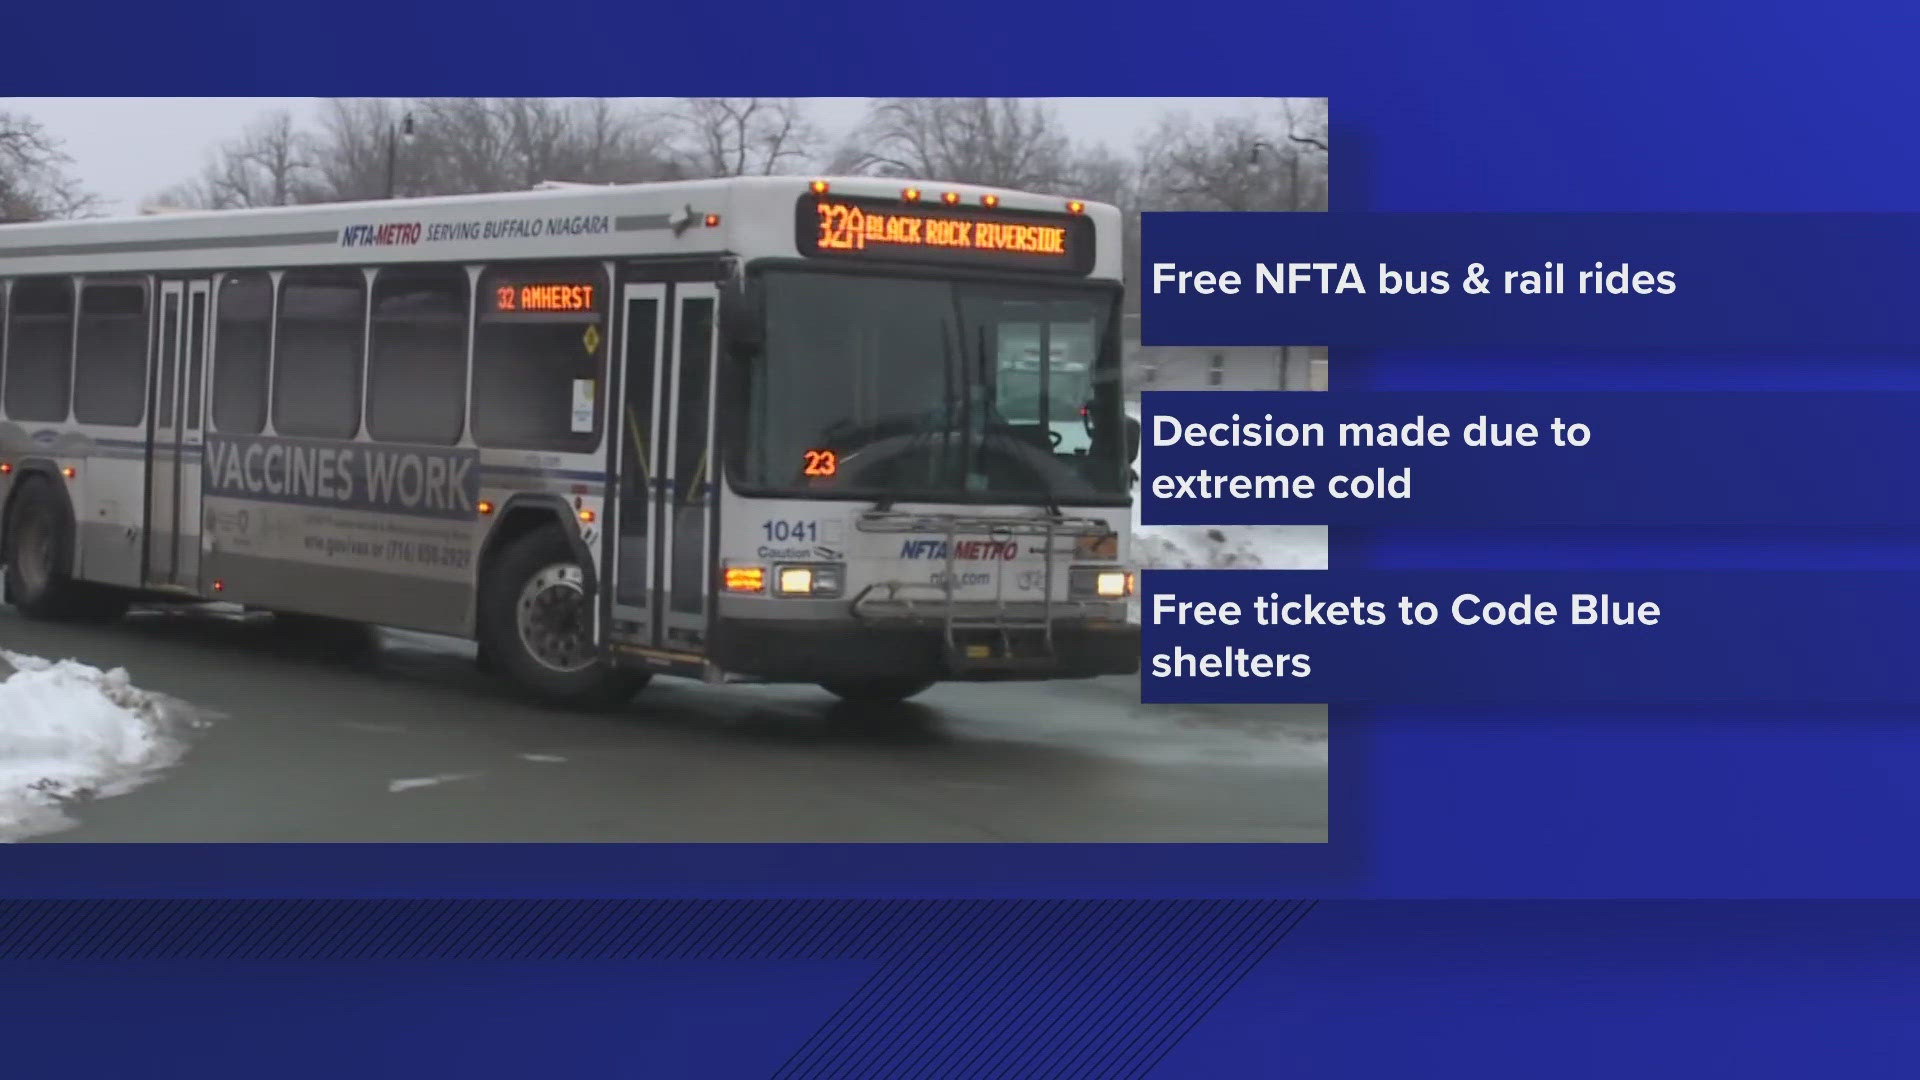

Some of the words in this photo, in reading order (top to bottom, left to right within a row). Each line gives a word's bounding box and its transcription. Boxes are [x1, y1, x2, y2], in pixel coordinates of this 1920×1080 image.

[342, 222, 421, 247] NFTA-METRO
[425, 221, 480, 242] SERVING
[483, 218, 542, 239] BUFFALO
[545, 215, 609, 235] NIAGARA
[816, 203, 864, 249] 32A
[865, 214, 921, 243] BLACK
[925, 219, 972, 249] ROCK
[975, 222, 1066, 254] RIVERSIDE
[497, 286, 515, 310] 32
[521, 285, 594, 309] AMHERST
[206, 440, 354, 500] VACCINES
[364, 451, 472, 512] WORK
[803, 450, 836, 476] 23
[763, 520, 816, 542] 1041
[758, 546, 811, 559] Caution
